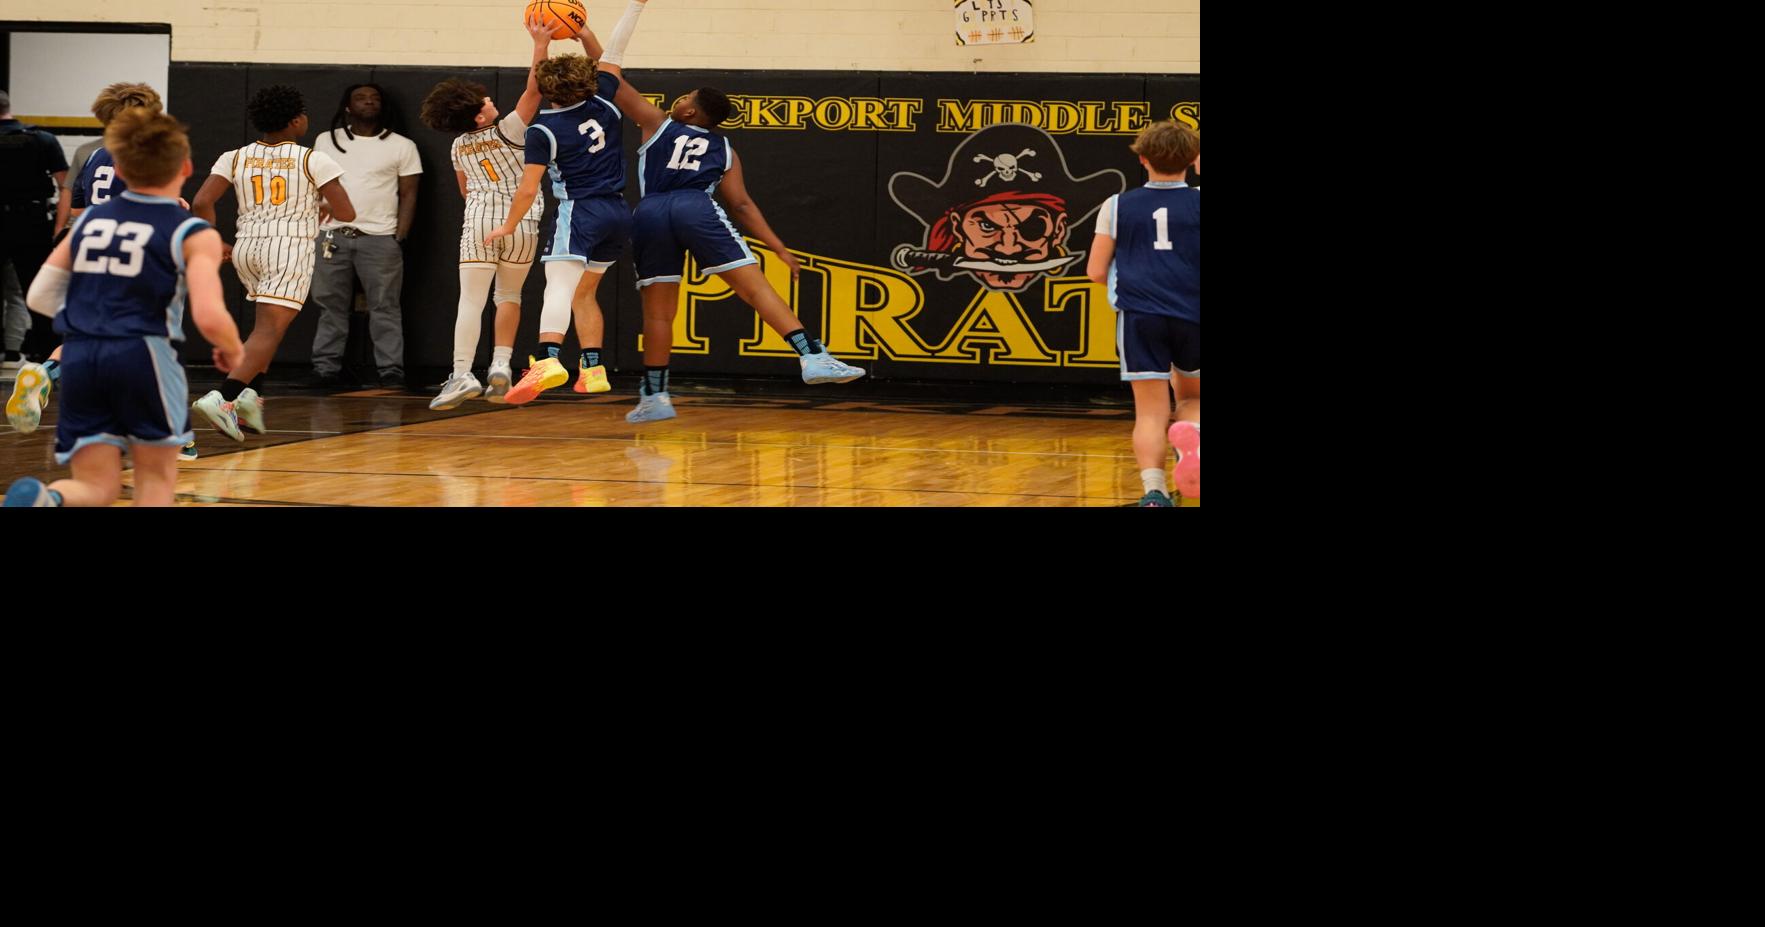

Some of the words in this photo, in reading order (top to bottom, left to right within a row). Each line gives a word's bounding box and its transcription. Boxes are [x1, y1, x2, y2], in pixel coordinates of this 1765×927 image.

[637, 93, 923, 132] CKPORT
[937, 99, 1152, 135] MIDDLE
[578, 118, 605, 154] 3
[666, 134, 710, 172] 12
[480, 158, 501, 182] 1
[250, 174, 287, 206] 10
[1152, 207, 1173, 250] 1
[73, 218, 155, 278] 23
